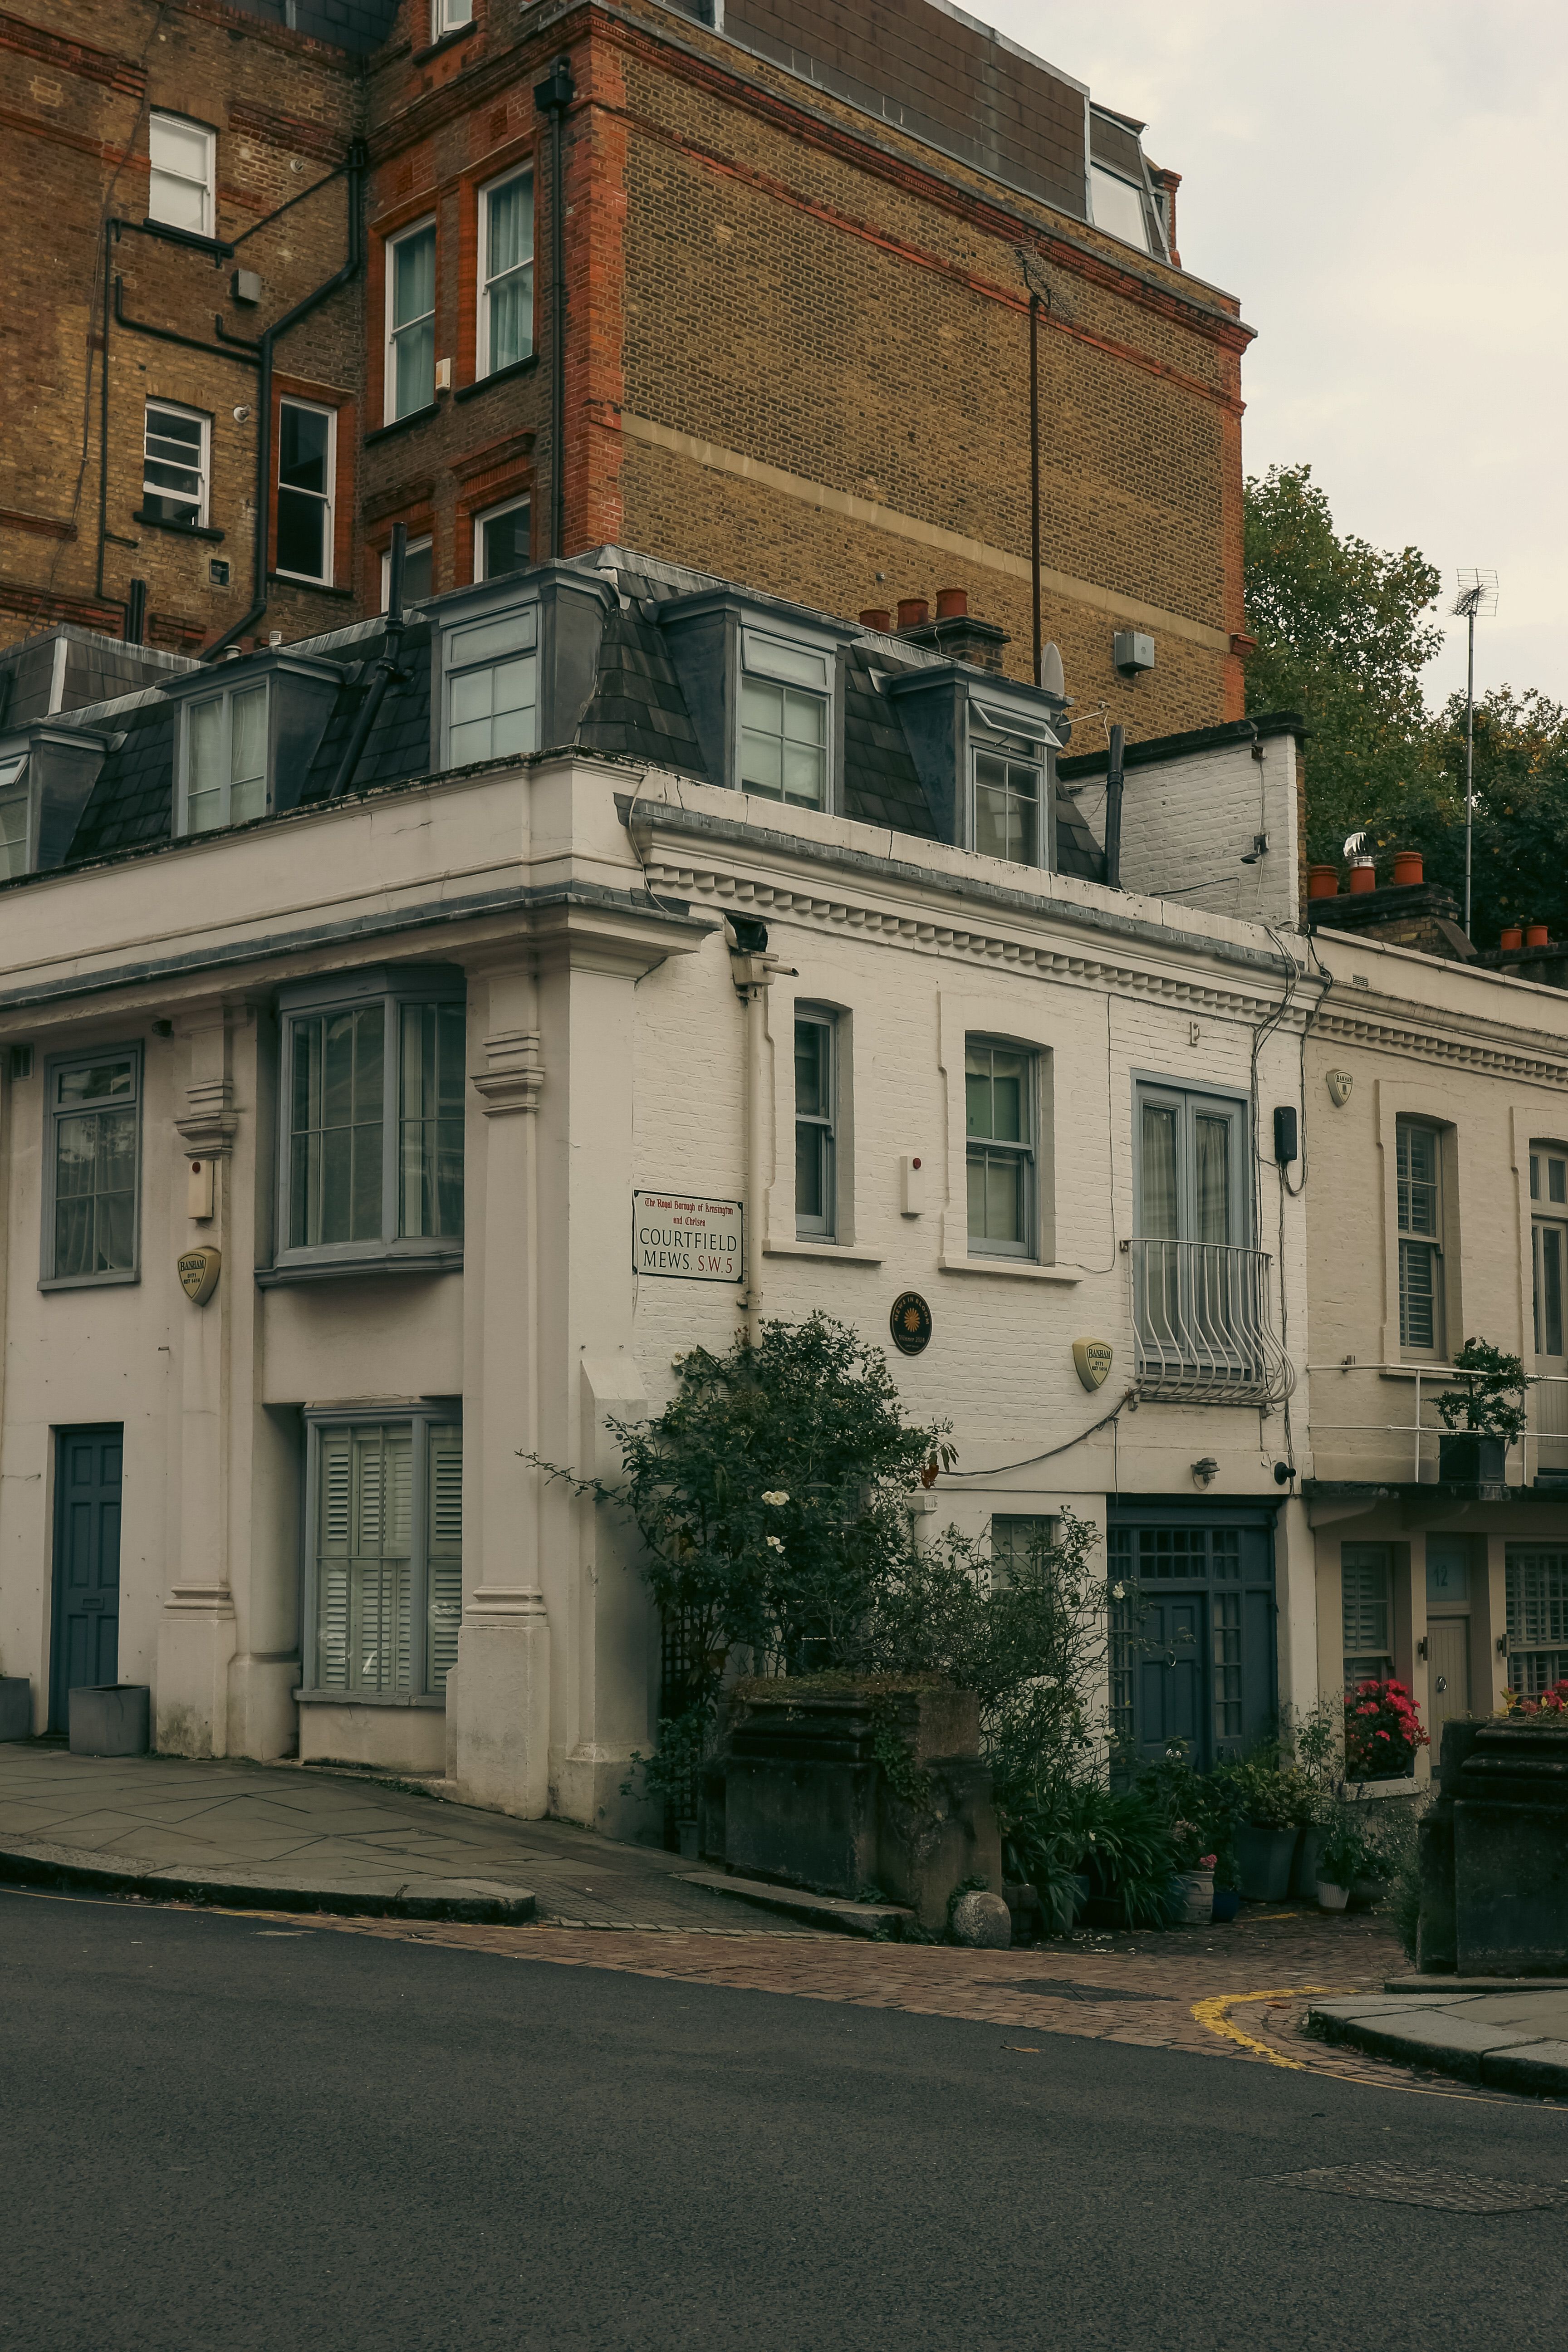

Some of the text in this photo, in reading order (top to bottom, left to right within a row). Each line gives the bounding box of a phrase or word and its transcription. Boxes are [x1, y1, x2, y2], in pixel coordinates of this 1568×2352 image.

[645, 1197, 733, 1217] The Royal Borough of Kensington
[673, 1216, 706, 1227] and Chelsea
[640, 1228, 737, 1252] COURTFIELD
[180, 1259, 204, 1272] BANHAM
[643, 1250, 692, 1271] MEWS,
[894, 1299, 906, 1321] MEWS
[916, 1298, 929, 1324] BLOOM
[1088, 1348, 1111, 1358] BANHAM
[1434, 1565, 1448, 1587] 12
